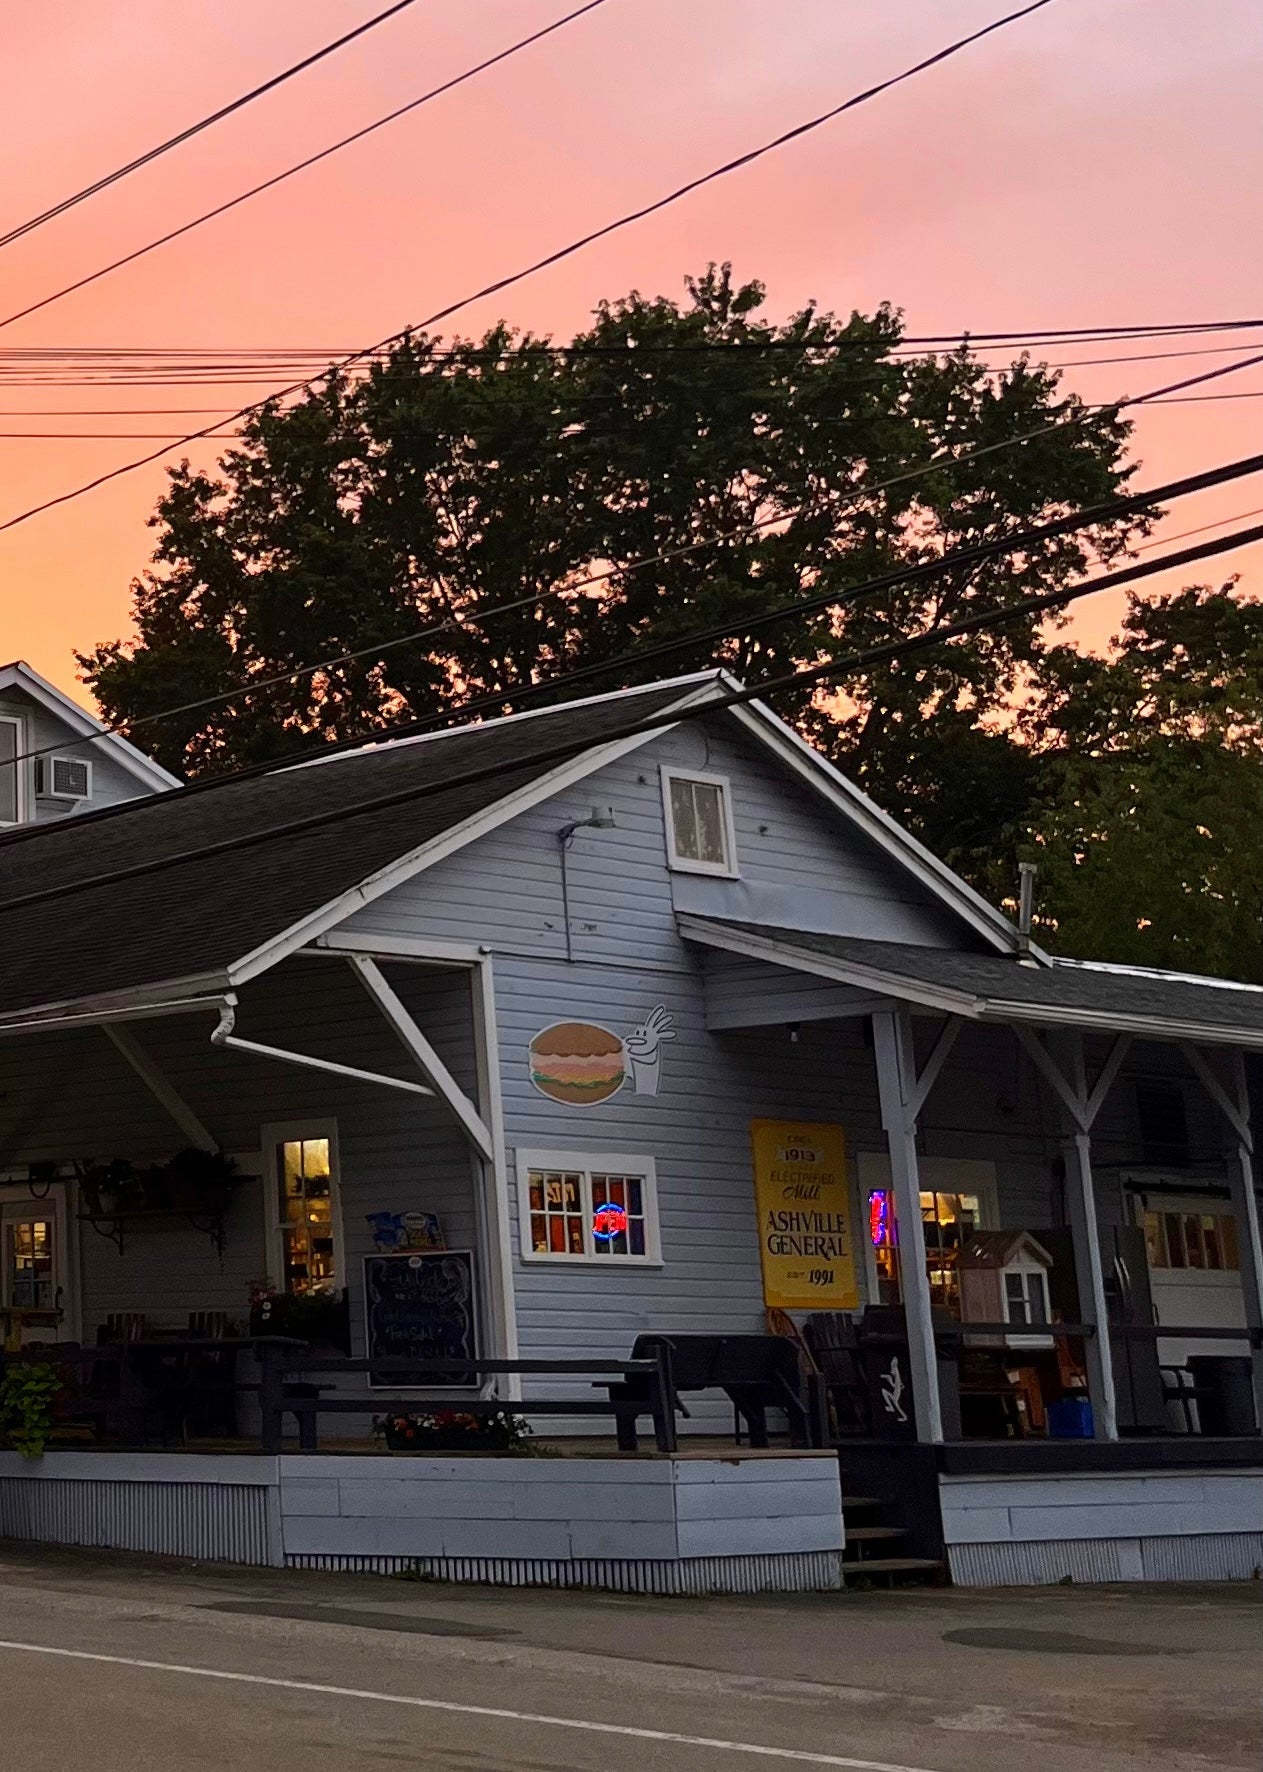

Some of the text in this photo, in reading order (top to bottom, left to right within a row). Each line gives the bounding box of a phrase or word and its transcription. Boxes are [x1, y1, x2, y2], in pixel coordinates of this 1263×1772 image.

[785, 1148, 816, 1162] 1913
[769, 1169, 836, 1185] ELECTRIFIED
[782, 1183, 821, 1201] Mill
[767, 1209, 847, 1234] ASHVILLE
[767, 1234, 849, 1262] GENERAL
[809, 1268, 834, 1286] 1991
